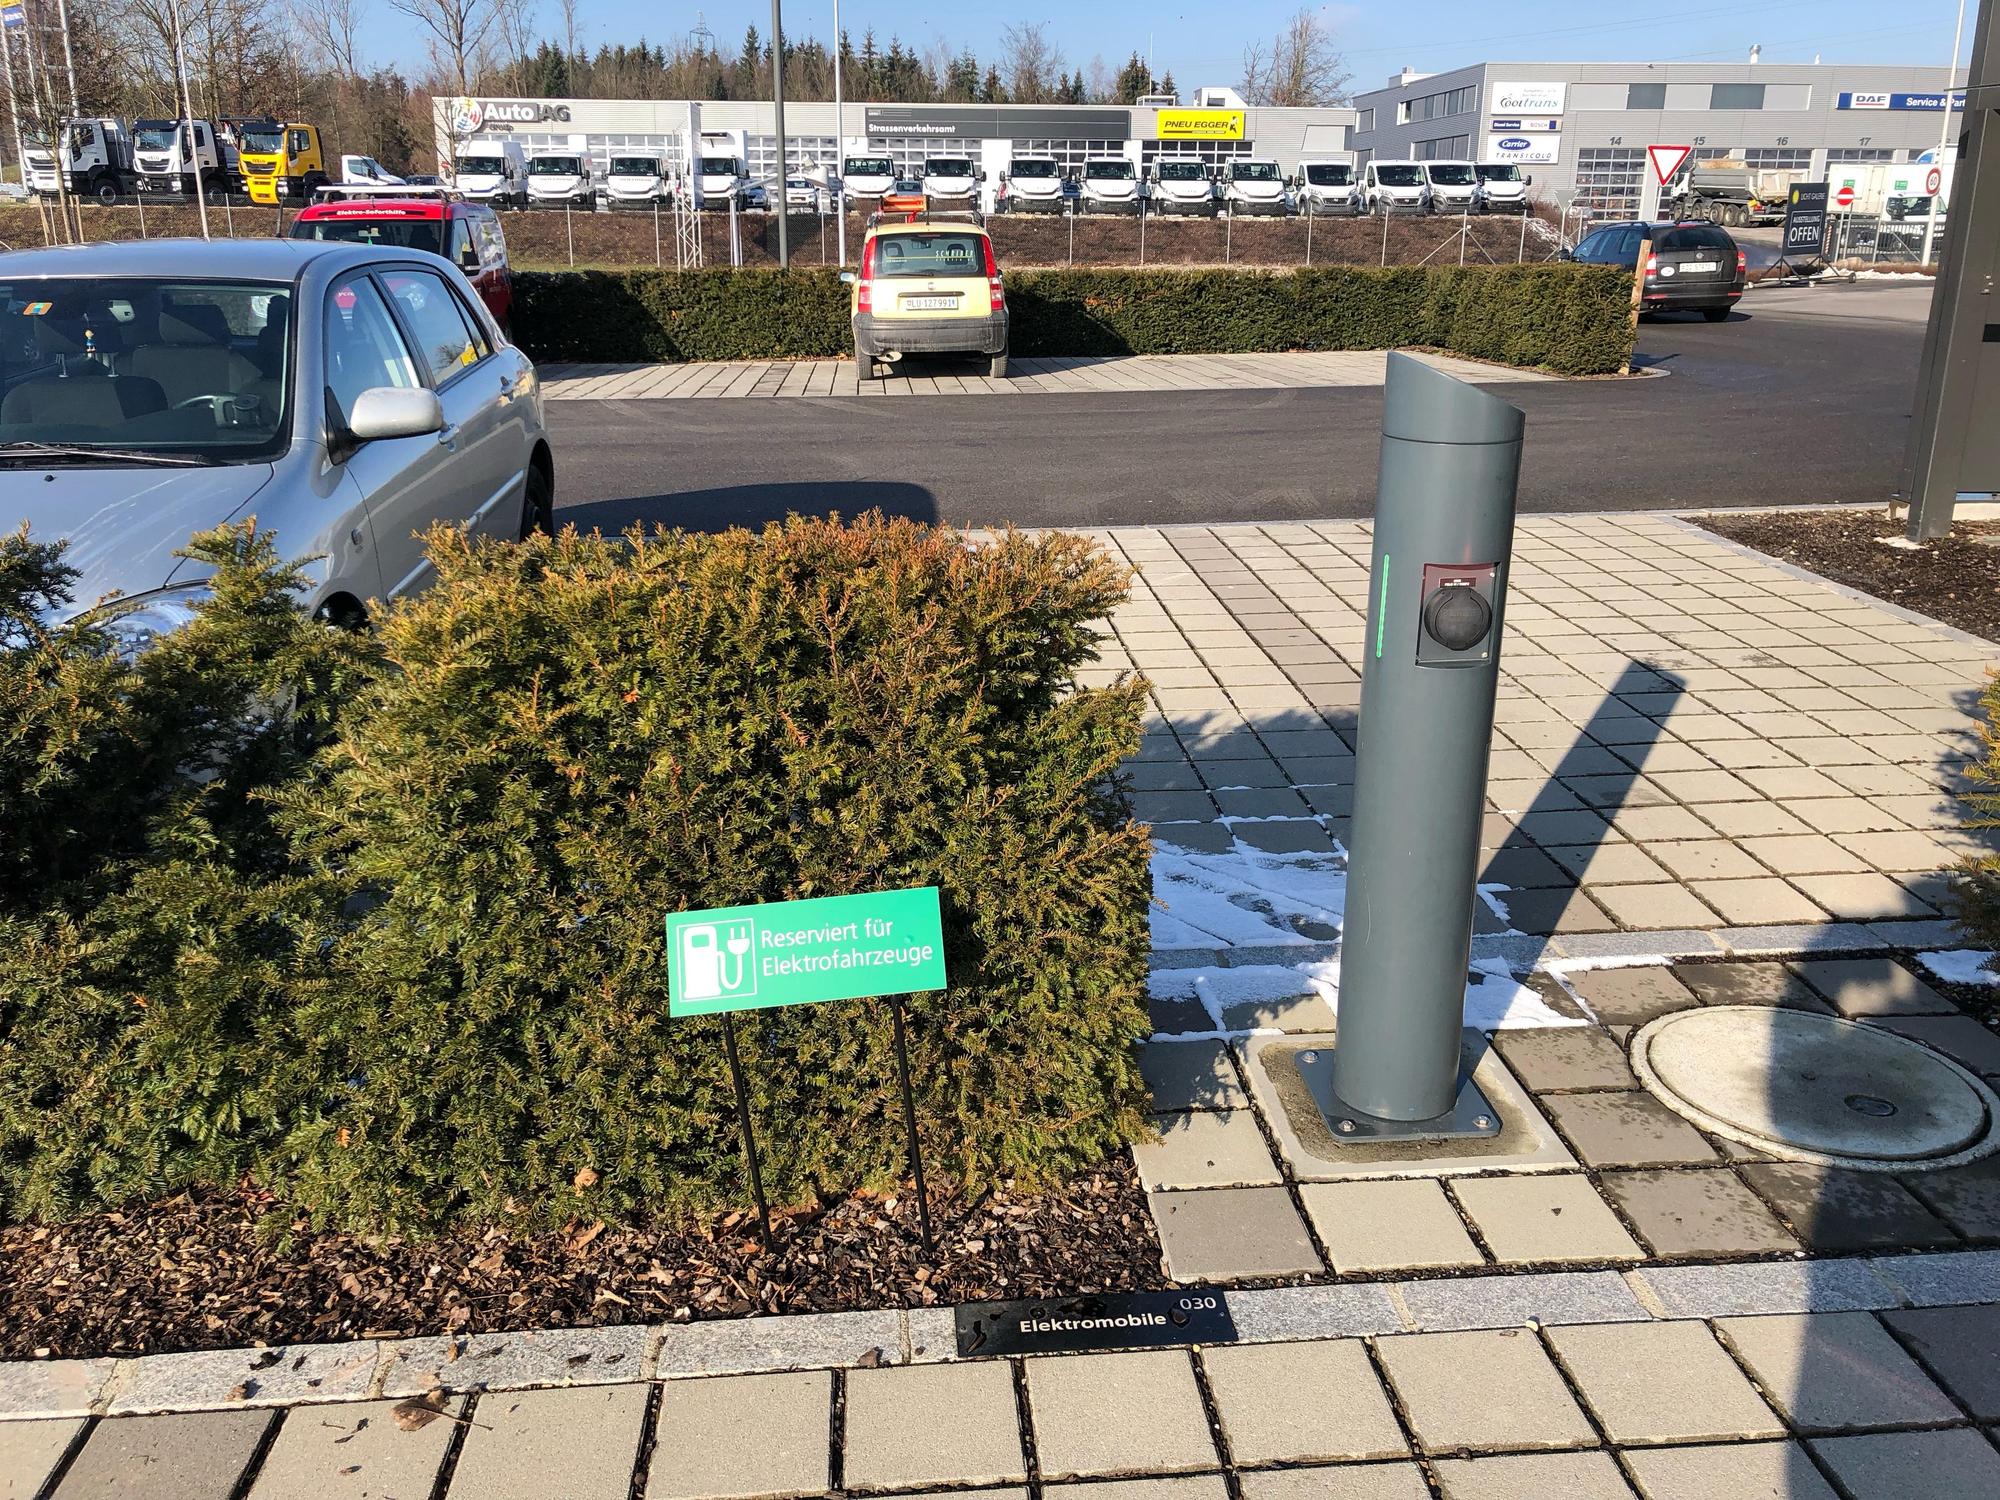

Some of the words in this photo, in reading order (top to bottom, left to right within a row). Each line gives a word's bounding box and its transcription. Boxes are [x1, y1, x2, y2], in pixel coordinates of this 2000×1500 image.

[1906, 97, 1938, 107] Service
[1939, 98, 1947, 107] &
[484, 103, 535, 120] Auto
[541, 105, 572, 122] AG
[868, 123, 956, 133] Strassenverkehrsamt
[1164, 120, 1193, 128] PNEU
[1502, 140, 1528, 148] Carrier
[1609, 136, 1622, 146] 14
[1693, 136, 1706, 146] 15
[1776, 136, 1789, 146] 16
[1859, 137, 1872, 146] 17
[1790, 226, 1820, 242] OFFEN
[761, 922, 858, 948] Reserviert
[864, 918, 893, 938] für
[763, 945, 933, 976] Elektrofahrzeuge
[1179, 1297, 1217, 1310] 030
[1019, 1313, 1167, 1333] Elektromobile
